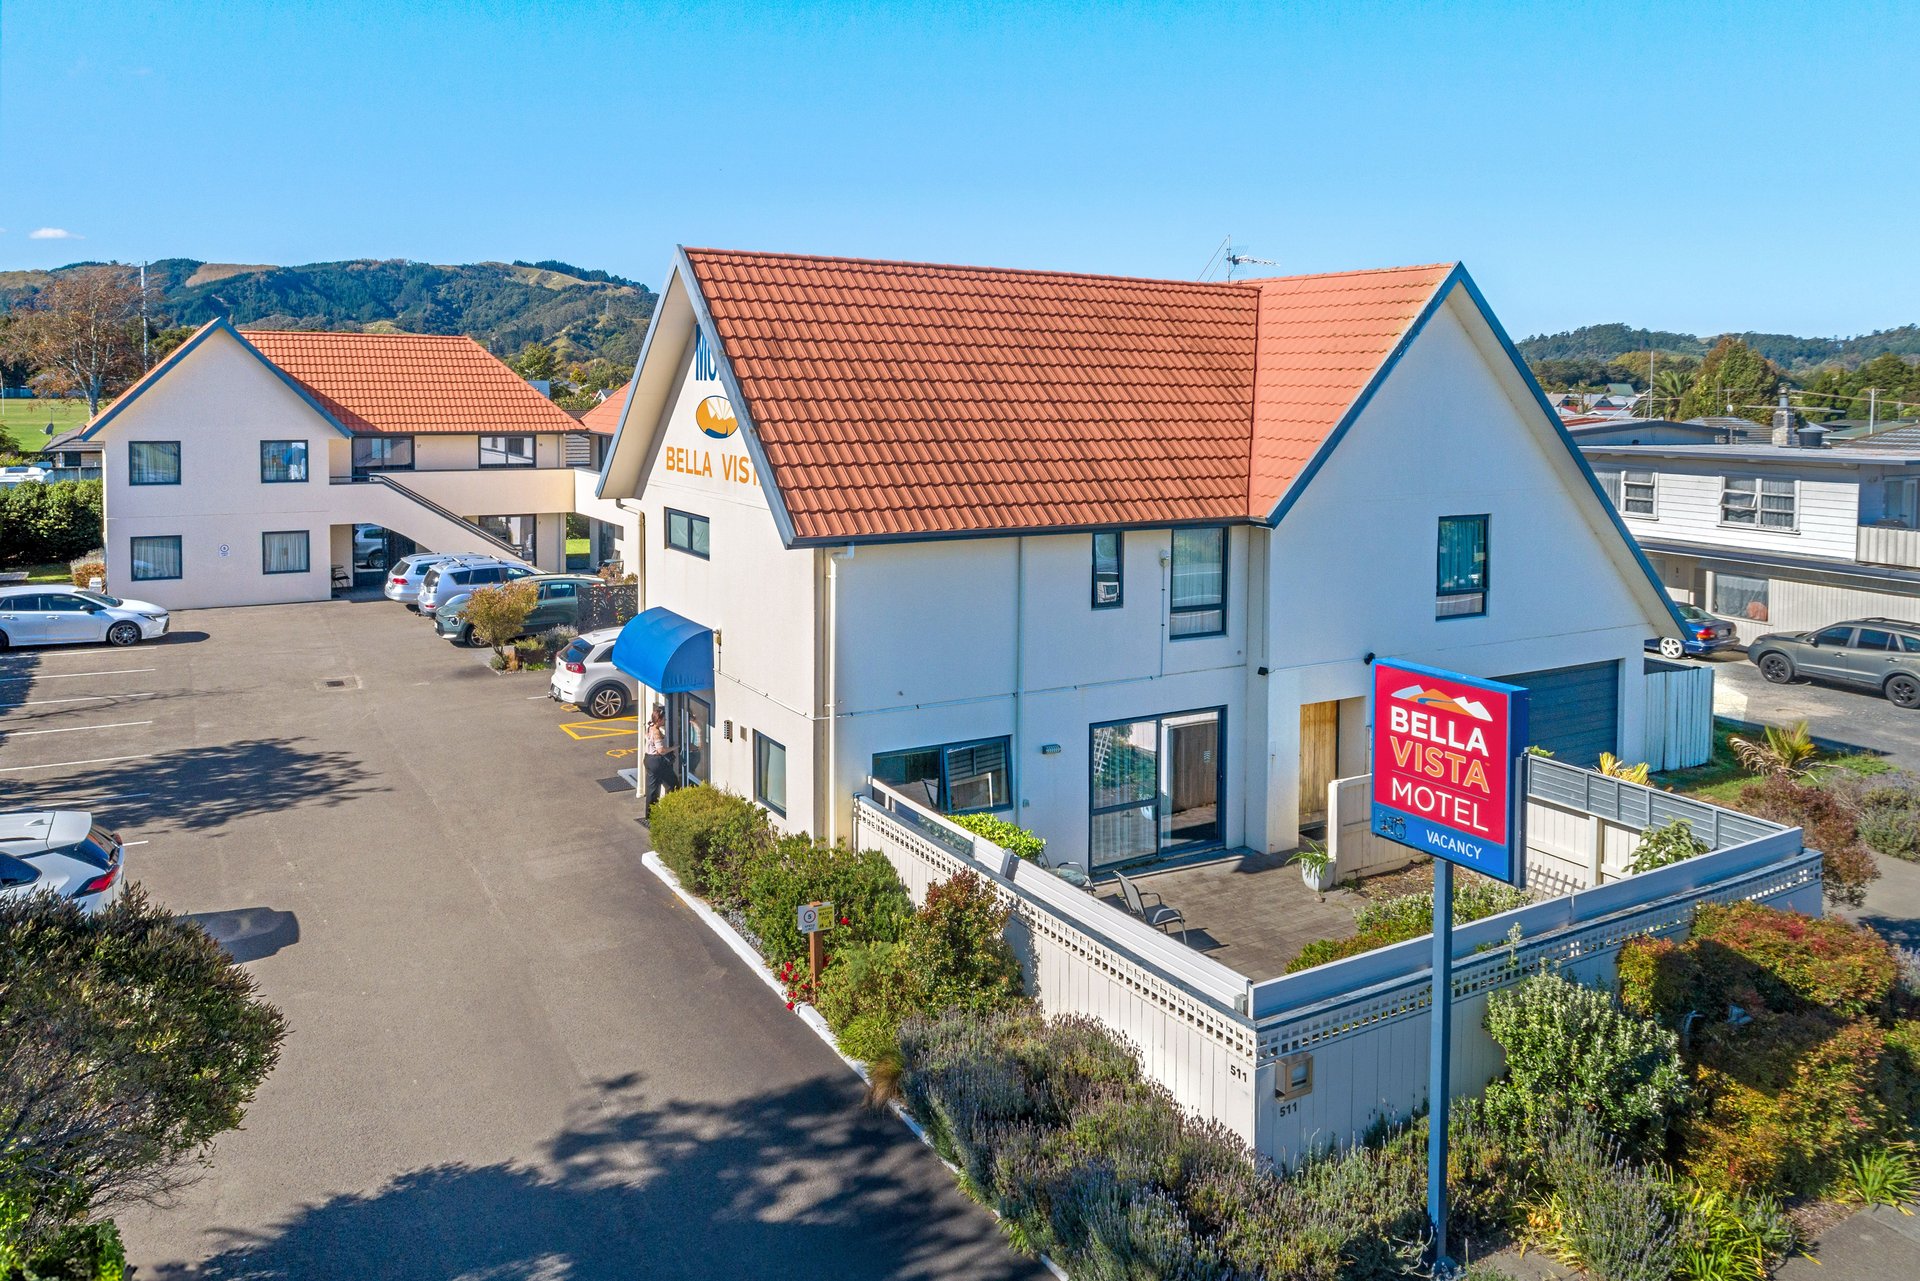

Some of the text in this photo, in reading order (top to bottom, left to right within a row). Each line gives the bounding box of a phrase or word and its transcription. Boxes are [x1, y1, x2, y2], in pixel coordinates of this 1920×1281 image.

[666, 446, 712, 478] BELLA
[1390, 705, 1489, 757] BELLA
[1390, 736, 1490, 793] VISTA
[1392, 777, 1489, 832] MOTEL
[1426, 829, 1482, 859] VACANCY
[1230, 1065, 1247, 1082] 511
[1280, 1102, 1297, 1117] 511
